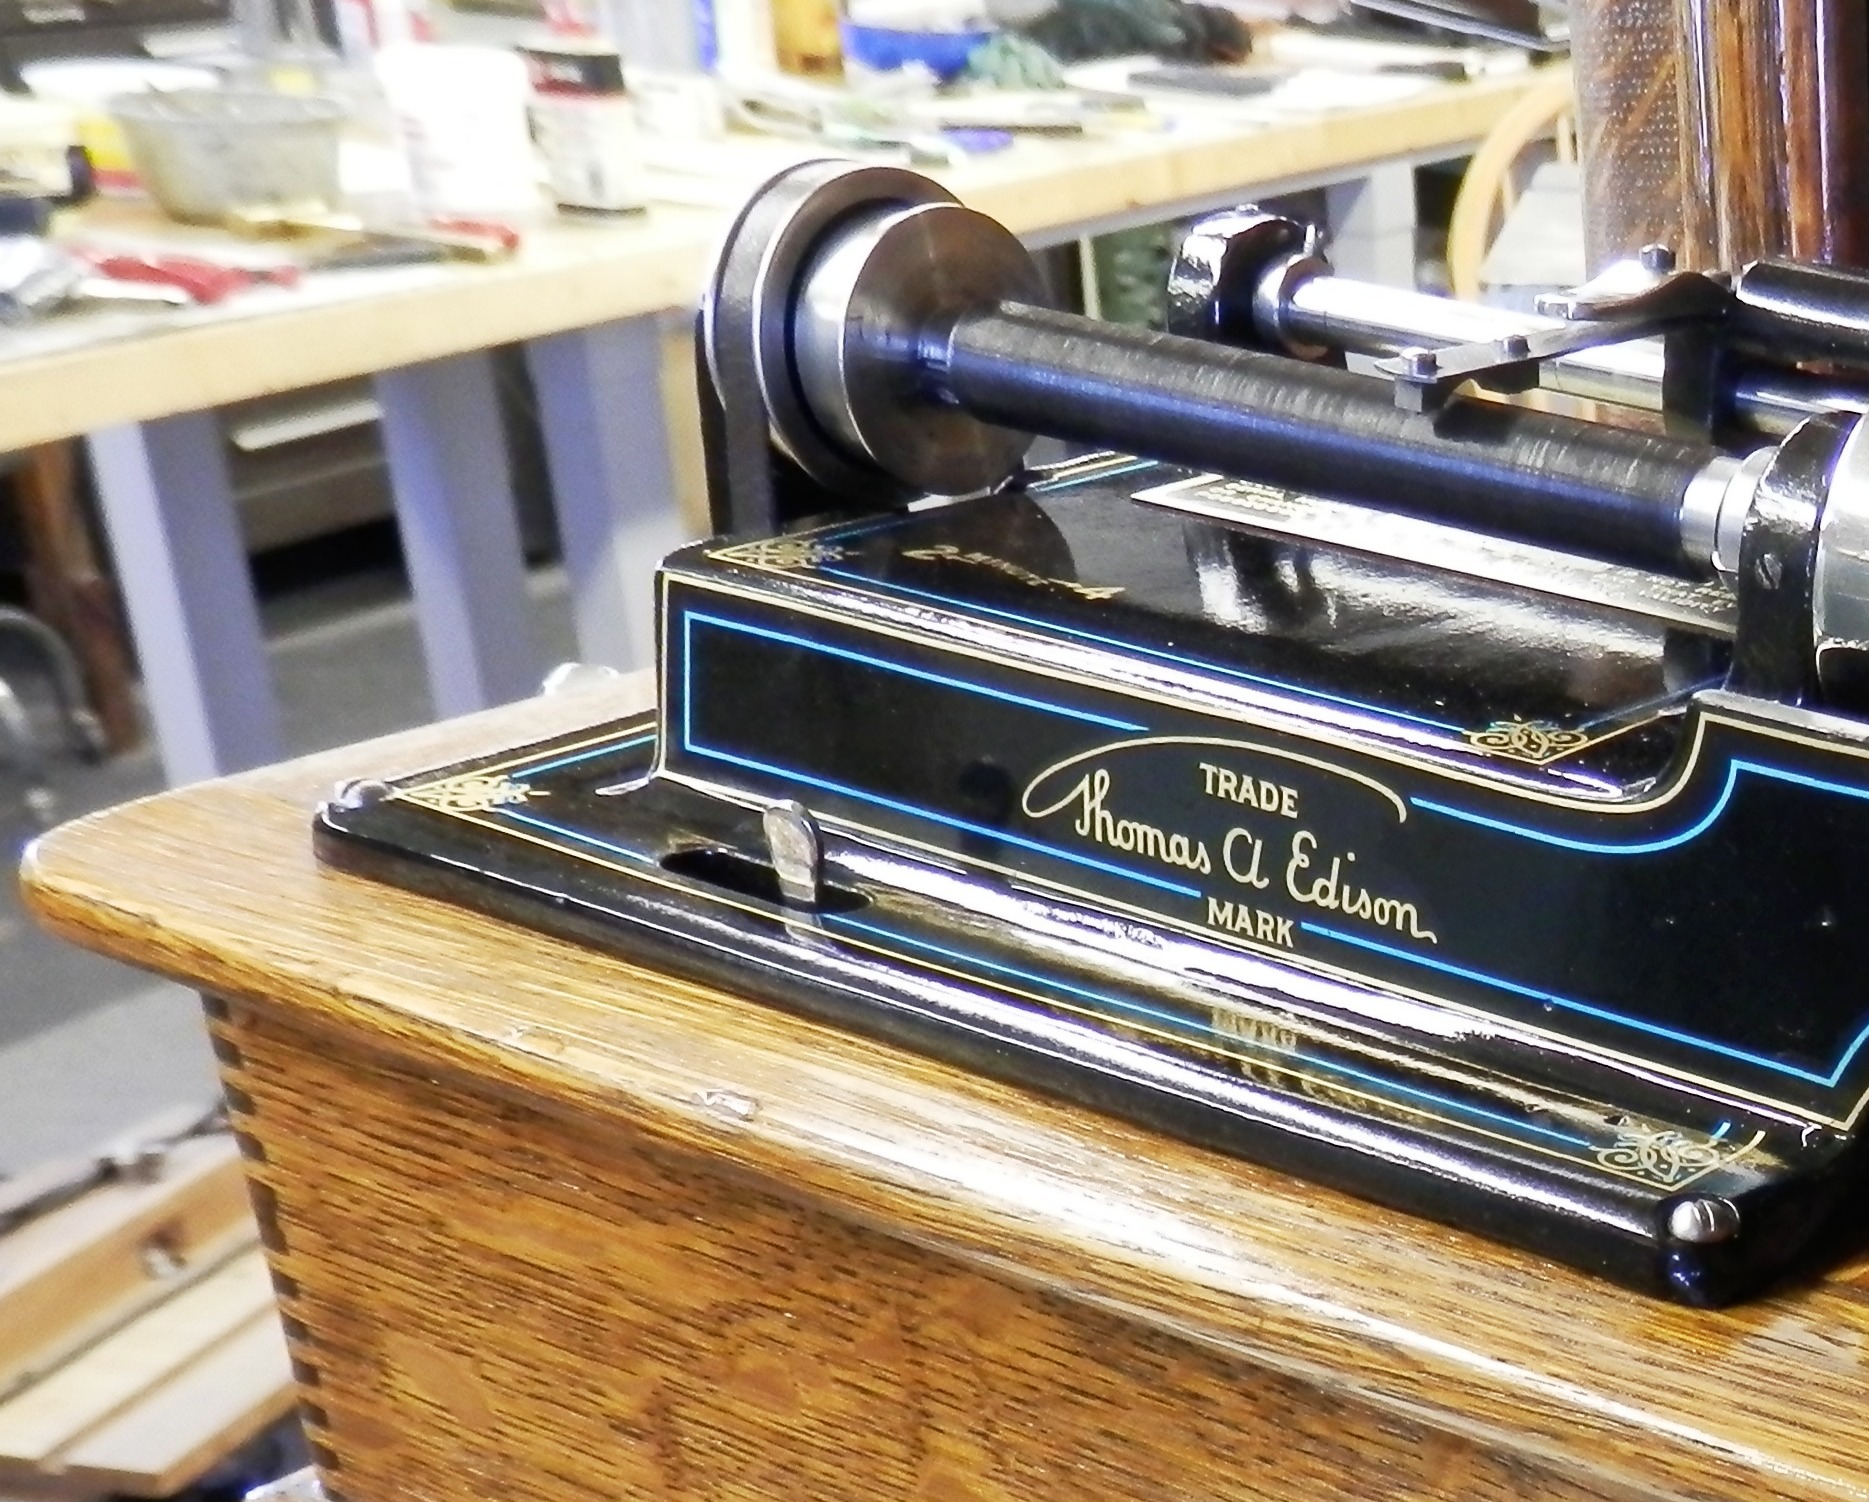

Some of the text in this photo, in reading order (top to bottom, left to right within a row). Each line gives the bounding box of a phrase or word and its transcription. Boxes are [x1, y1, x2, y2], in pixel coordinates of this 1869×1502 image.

[1199, 762, 1299, 819] TRADE
[1022, 768, 1438, 944] Thomas A Edison
[1205, 897, 1295, 948] MARK
